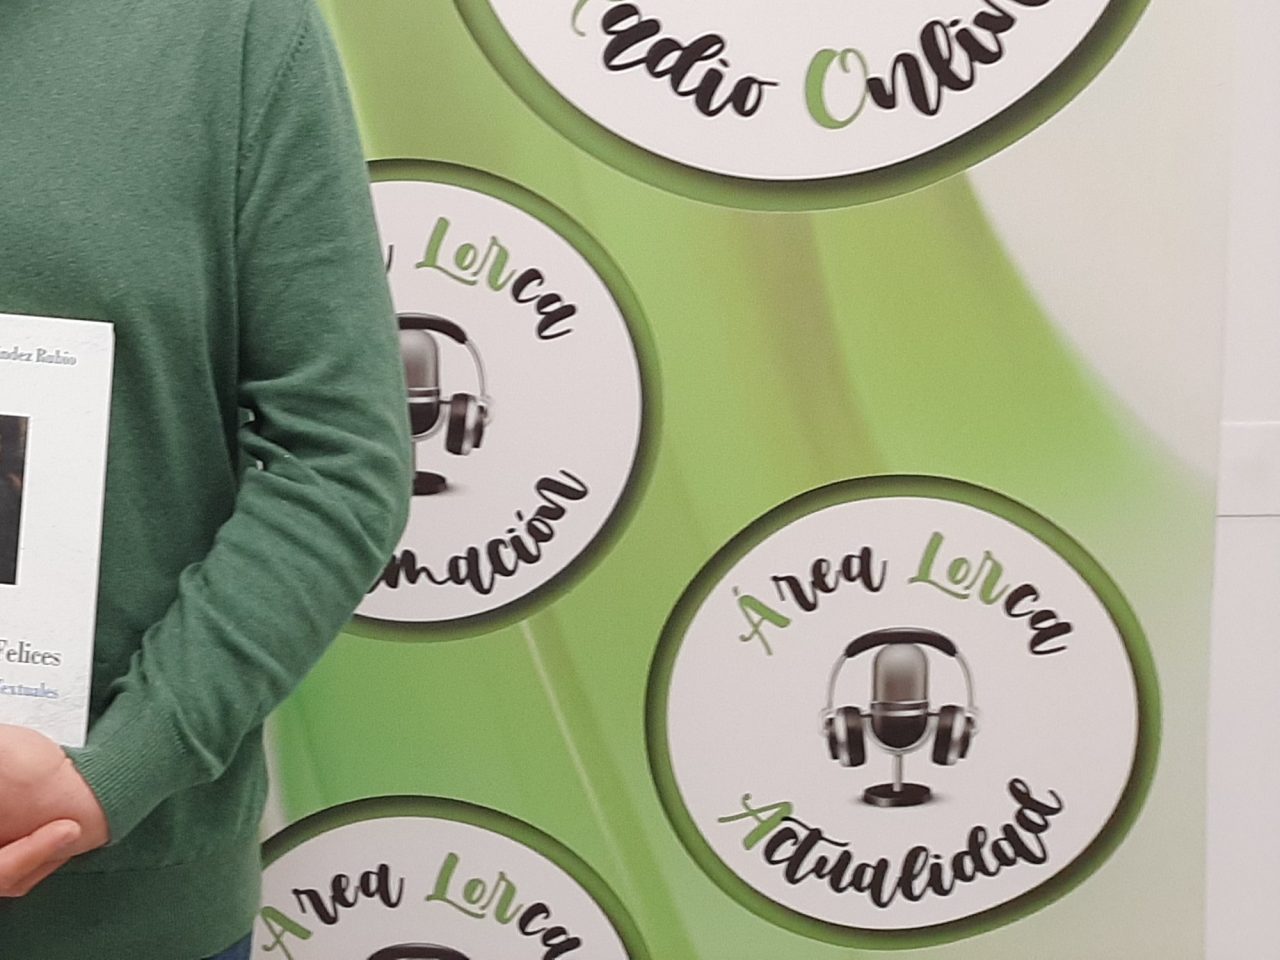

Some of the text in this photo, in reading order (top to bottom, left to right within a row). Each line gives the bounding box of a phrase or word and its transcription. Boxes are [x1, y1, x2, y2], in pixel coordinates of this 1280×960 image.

[415, 216, 579, 342] Lorca
[35, 347, 77, 366] Rubio
[366, 468, 588, 596] mación
[732, 531, 1073, 656] Área Lorca
[424, 851, 583, 960] Lorca
[717, 777, 1065, 909] Actualidad
